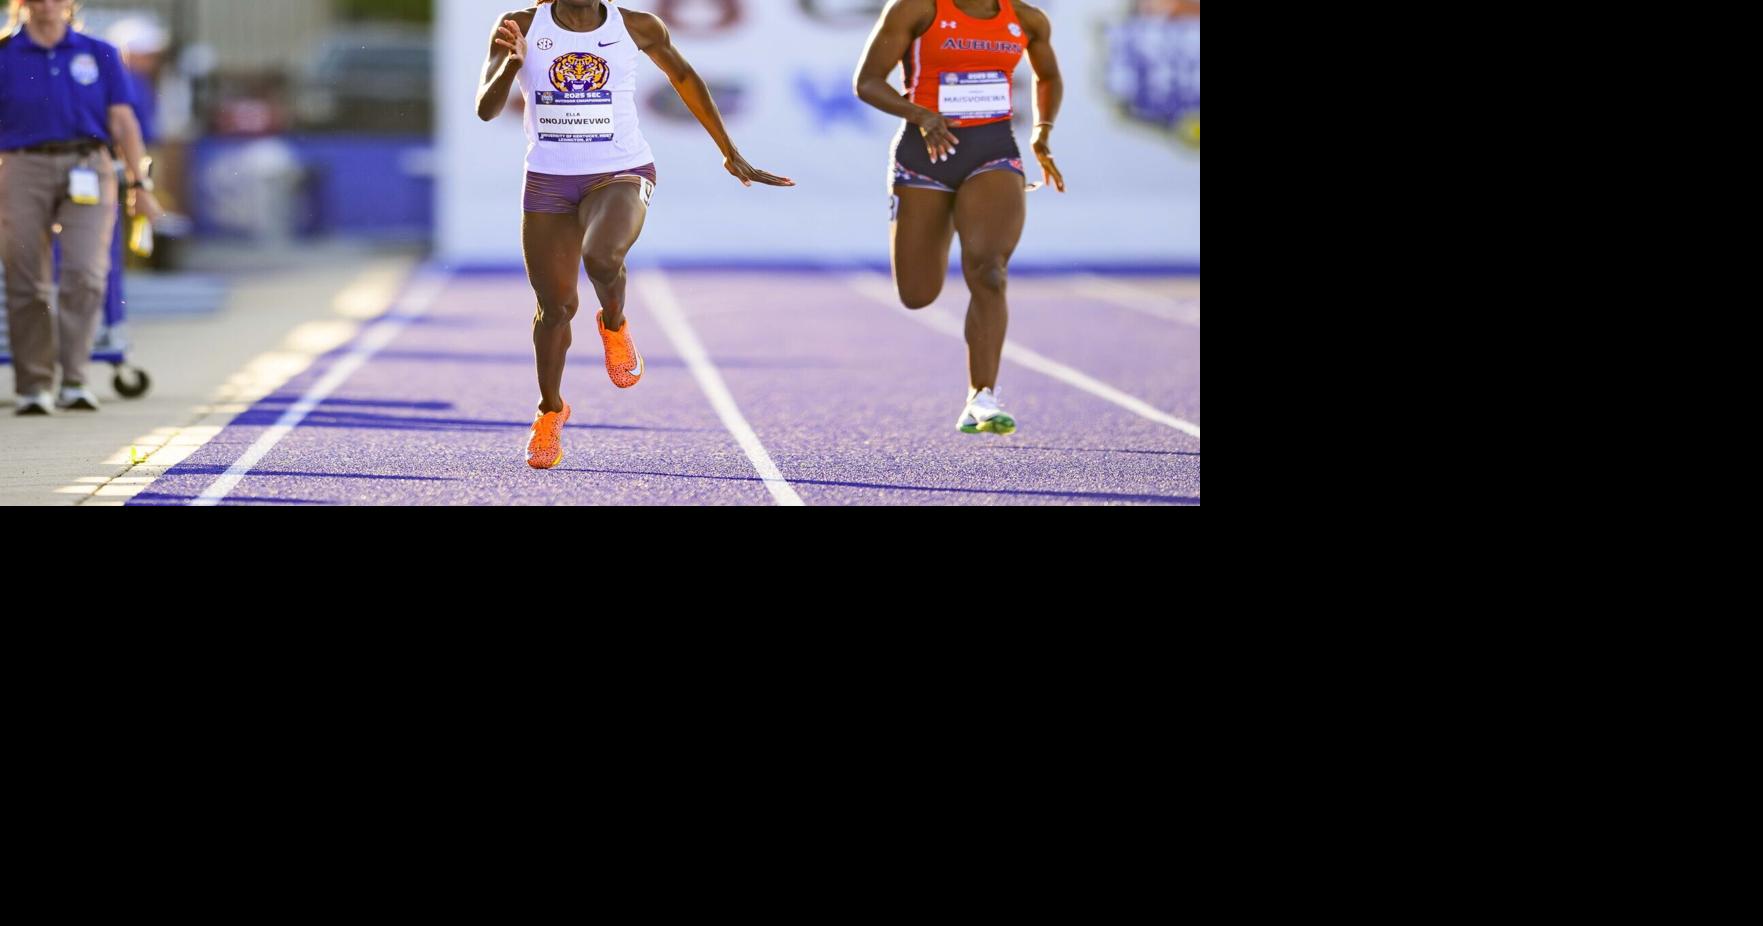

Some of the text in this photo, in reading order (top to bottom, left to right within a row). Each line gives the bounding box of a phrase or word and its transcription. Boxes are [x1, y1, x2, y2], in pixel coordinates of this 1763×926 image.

[537, 38, 553, 50] SEC
[941, 37, 1022, 54] AUBURN
[539, 117, 611, 125] ONOJUVWEVWO
